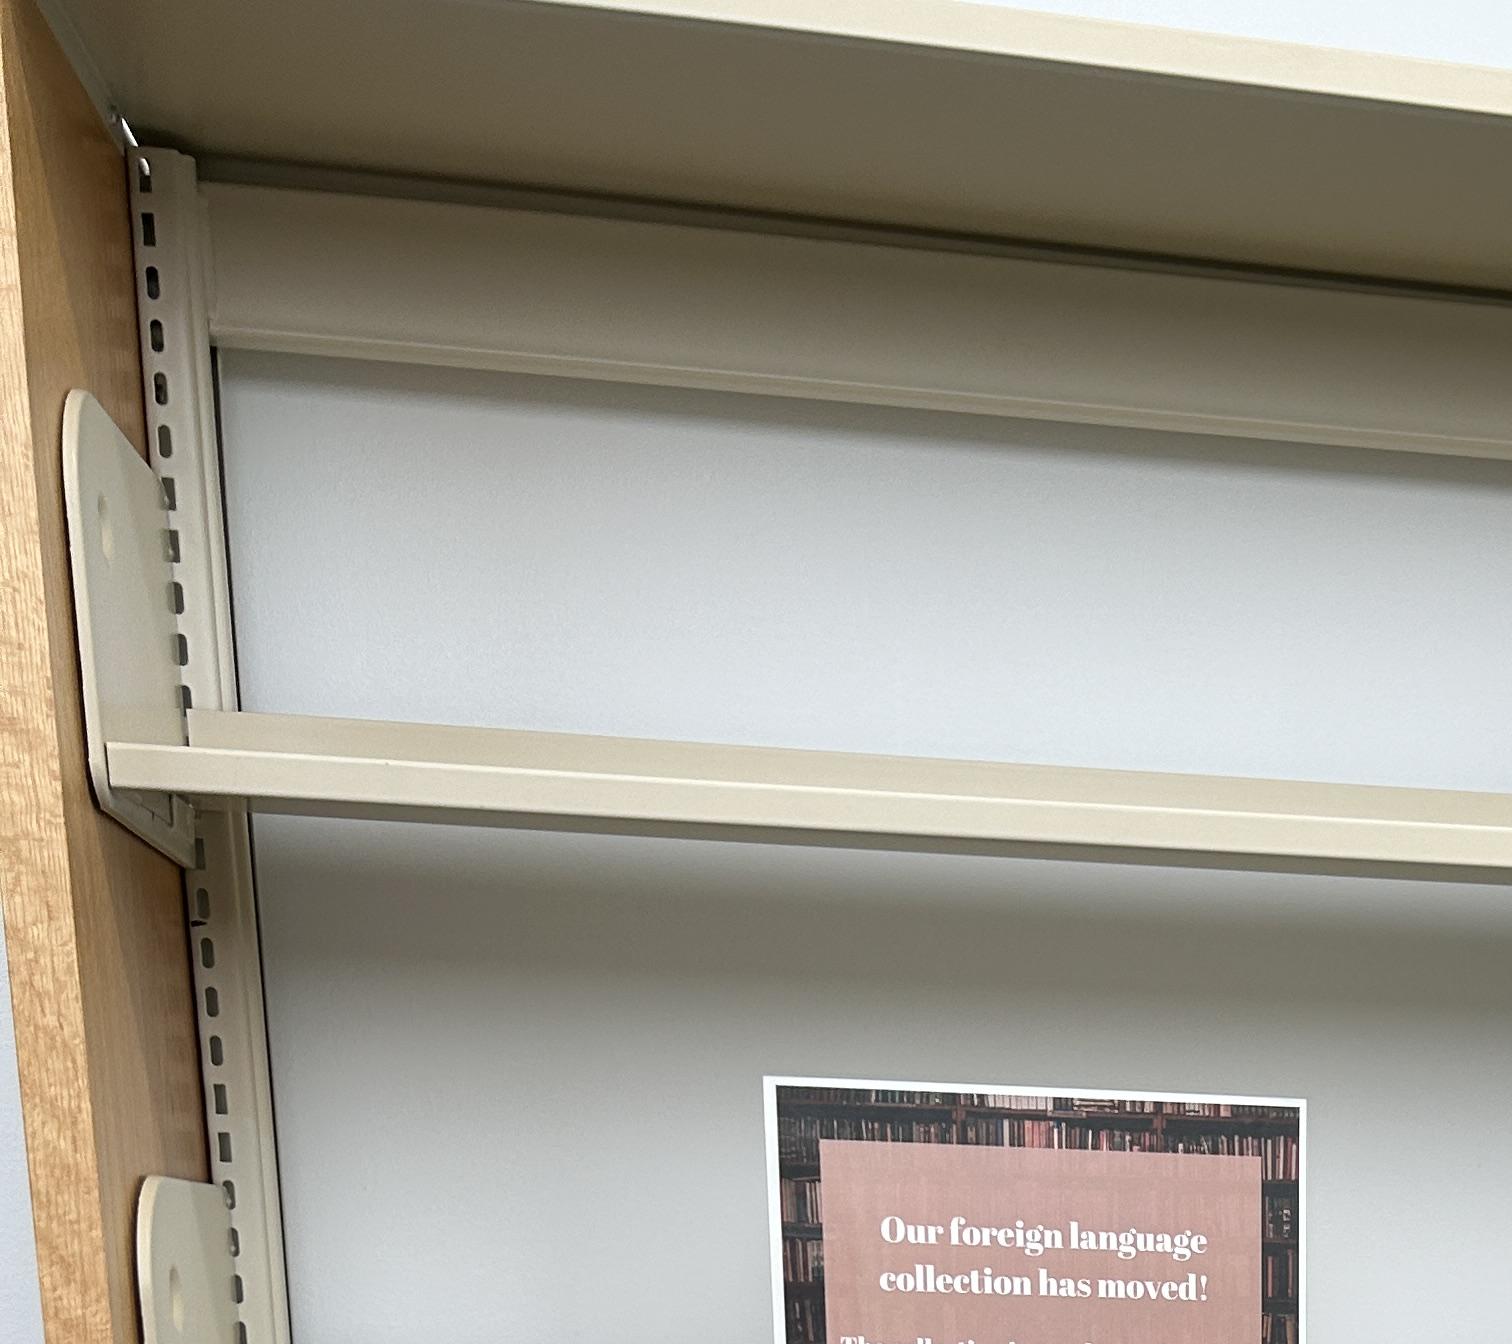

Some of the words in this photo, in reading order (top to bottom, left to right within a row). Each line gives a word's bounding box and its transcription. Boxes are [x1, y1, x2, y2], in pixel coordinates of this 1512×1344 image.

[880, 1215, 945, 1245] Our
[949, 1216, 1065, 1257] foreign
[1069, 1220, 1208, 1262] language
[879, 1263, 1032, 1296] collection
[1038, 1267, 1092, 1298] has
[1097, 1272, 1208, 1302] moved!
